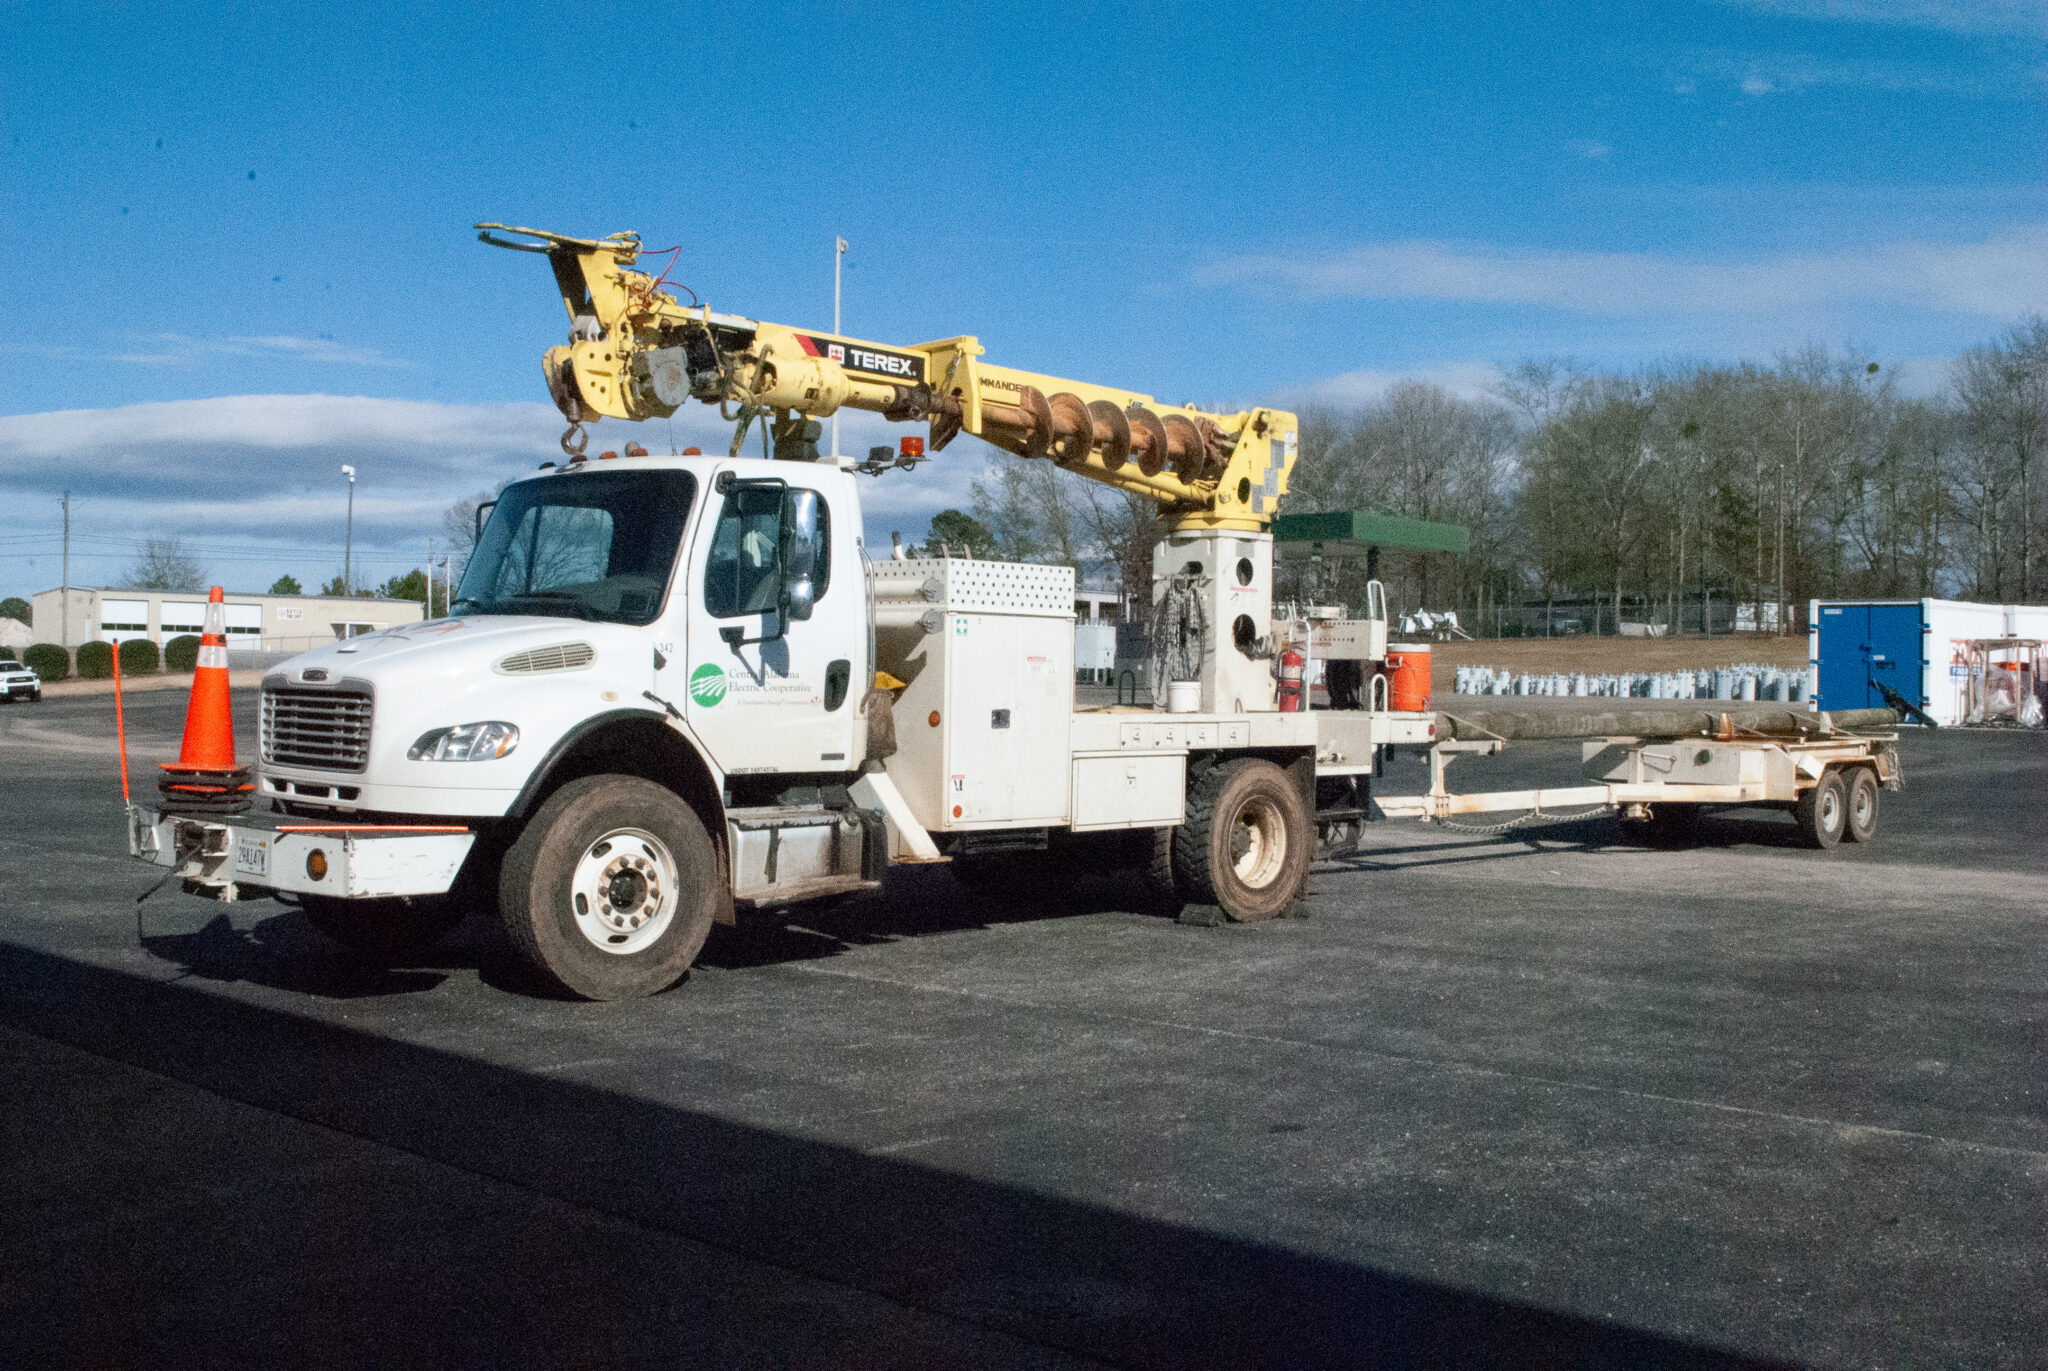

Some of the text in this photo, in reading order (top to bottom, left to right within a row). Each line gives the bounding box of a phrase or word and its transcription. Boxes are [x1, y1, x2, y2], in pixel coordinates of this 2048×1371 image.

[728, 669, 800, 679] Central Alabama
[728, 682, 812, 693] Electric Cooperative
